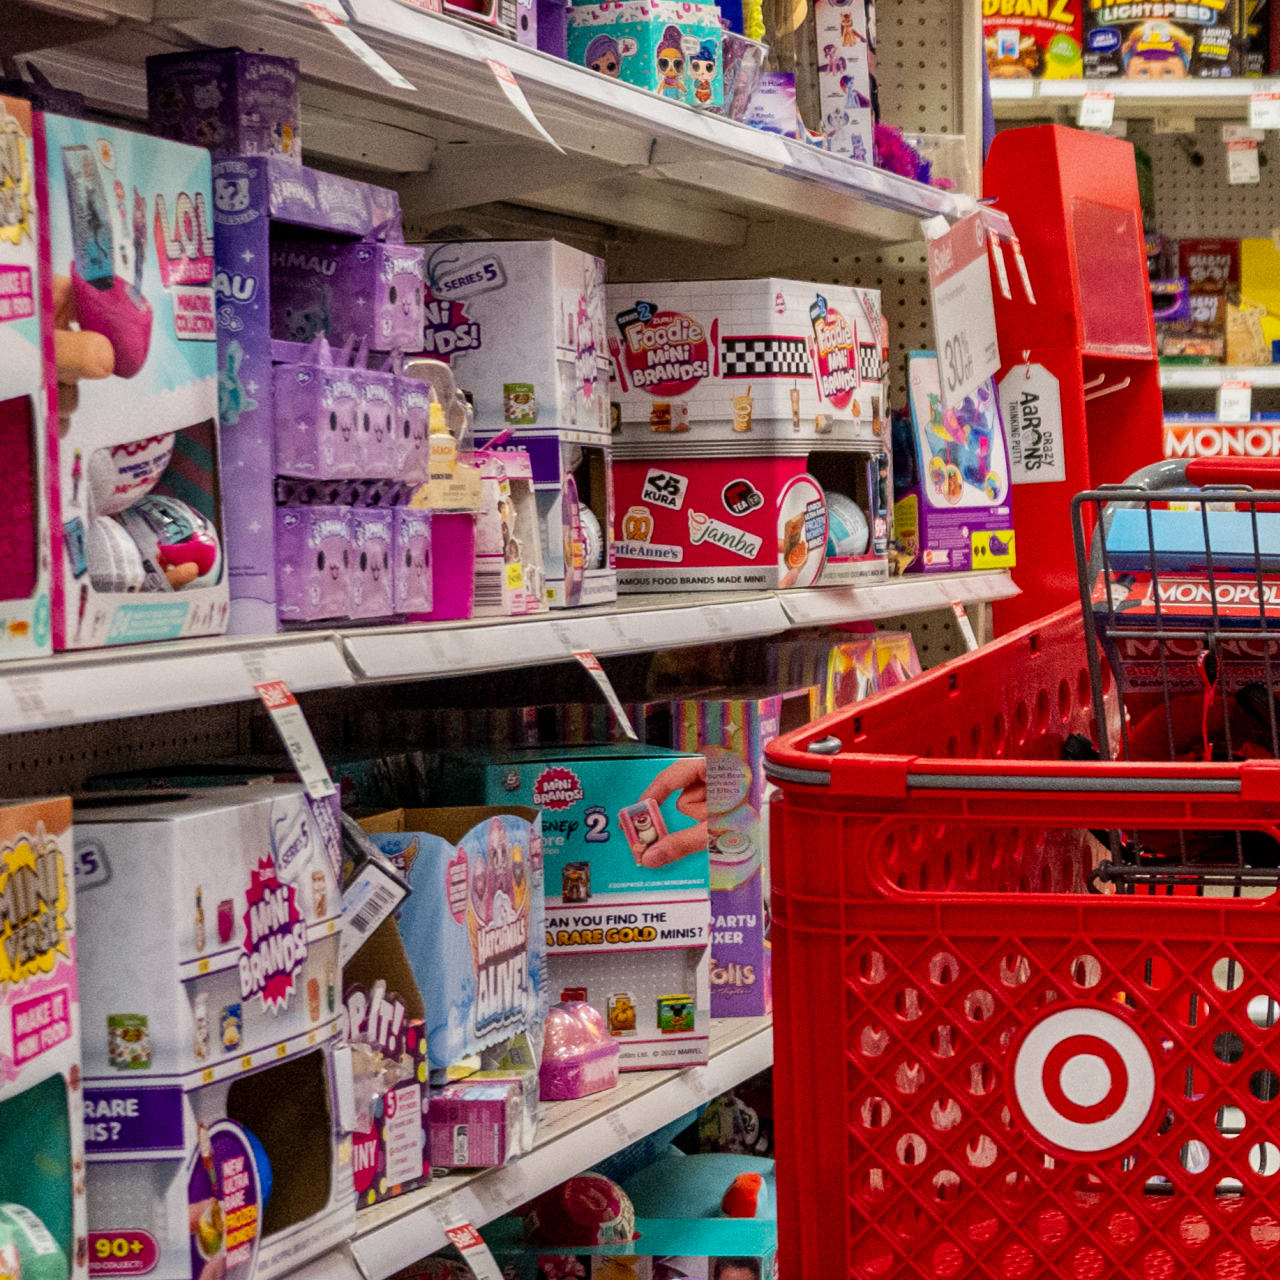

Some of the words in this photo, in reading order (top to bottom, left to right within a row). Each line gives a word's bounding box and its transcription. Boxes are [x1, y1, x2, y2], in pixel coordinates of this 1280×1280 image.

[1103, 2, 1212, 22] LIGHTSPEED
[443, 271, 484, 294] SERIES
[483, 263, 498, 283] 5
[627, 321, 704, 352] Foodie
[816, 324, 852, 352] Foodie
[631, 359, 710, 388] BRANDS!
[1009, 400, 1019, 439] THINKING
[1011, 440, 1023, 466] PUTTY
[643, 489, 679, 508] KURA
[698, 519, 757, 558] jamba
[617, 577, 651, 587] AMOUS
[652, 576, 679, 587] FOOD
[680, 576, 716, 586] BRANDS
[716, 575, 743, 585] MADE
[743, 575, 767, 585] MINI!
[532, 788, 585, 805] BRANDS!
[584, 811, 611, 844] 2
[79, 850, 99, 876] 5
[573, 915, 602, 927] YOU
[606, 913, 639, 926] FIND
[642, 911, 667, 924] THE
[556, 930, 604, 947] RARE
[604, 925, 658, 945] GOLD
[239, 920, 308, 1001] BRANDS!
[84, 1097, 140, 1119] RARE
[95, 1237, 145, 1258] 90+
